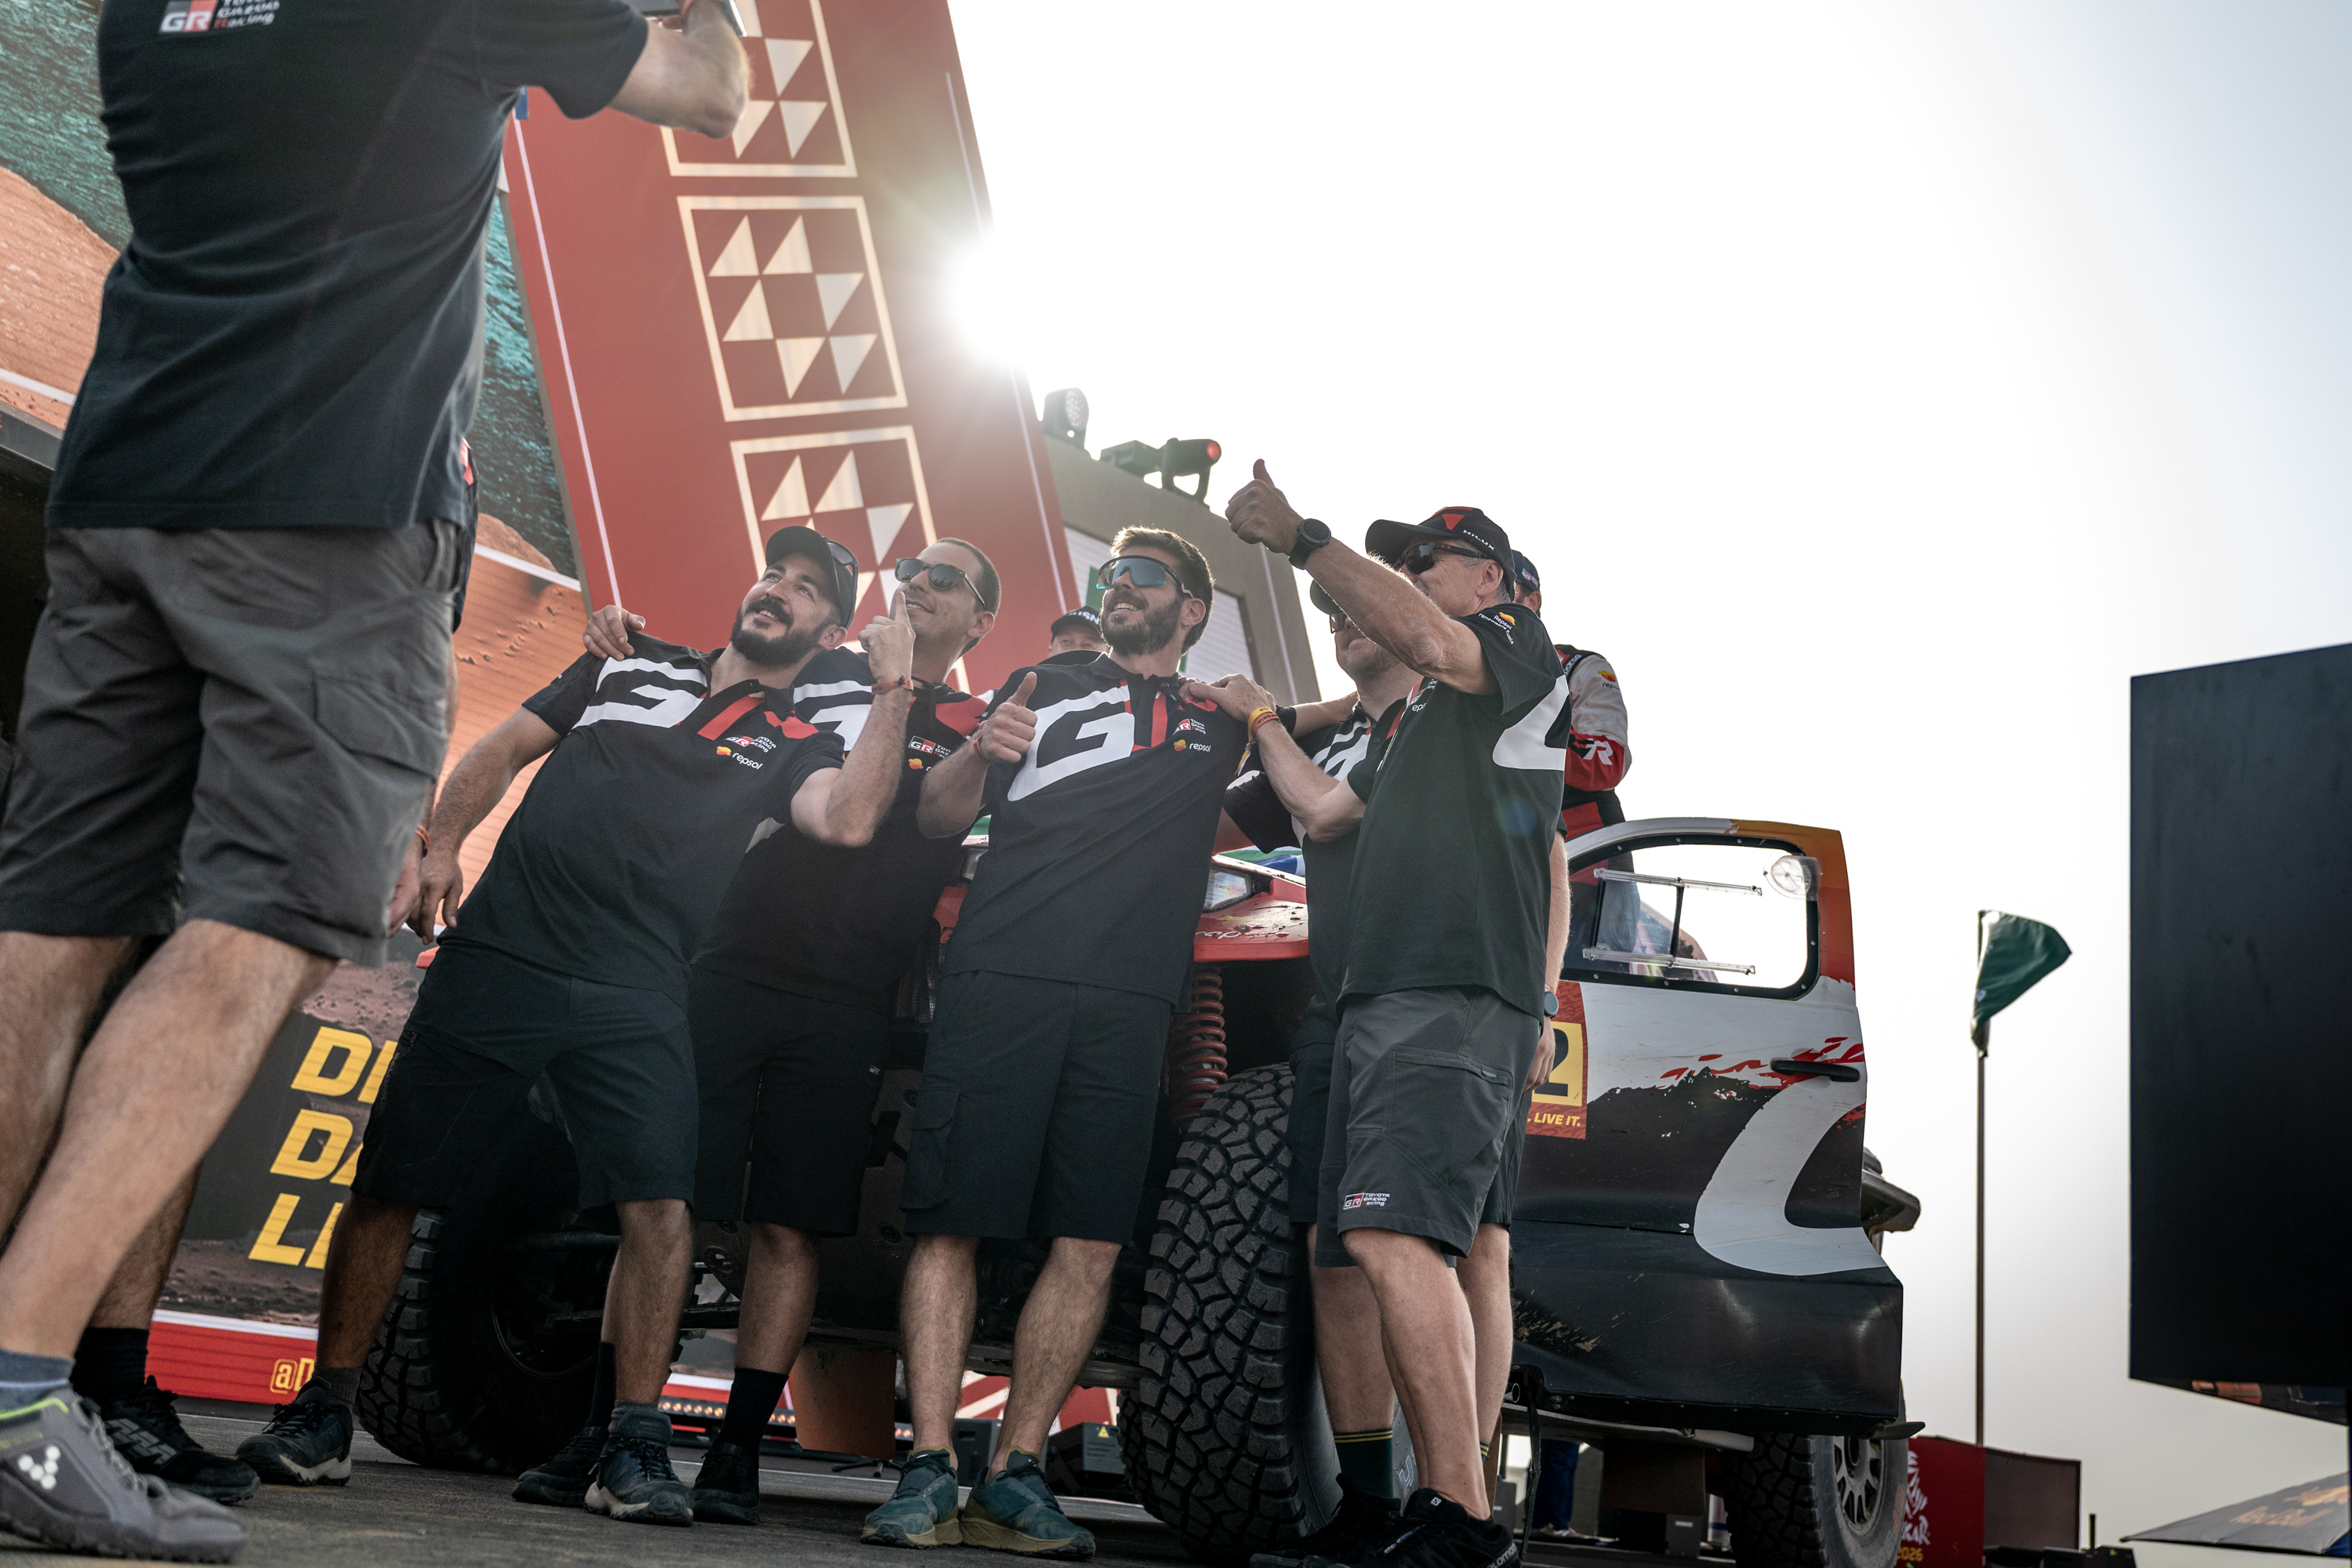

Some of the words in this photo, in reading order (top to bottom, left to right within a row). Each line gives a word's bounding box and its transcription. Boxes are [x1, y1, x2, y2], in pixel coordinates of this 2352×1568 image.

[160, 12, 212, 32] GR
[213, 12, 274, 29] Racing
[1463, 529, 1494, 551] HILUX
[1494, 615, 1512, 630] Repsol
[1505, 630, 1514, 644] fuels
[910, 741, 934, 753] GR
[1189, 742, 1211, 753] repsol
[731, 753, 764, 769] repsol
[1534, 1028, 1569, 1097] 2
[1534, 1112, 1565, 1126] LIVE
[1565, 1115, 1581, 1127] IT.
[270, 1357, 315, 1395] @D
